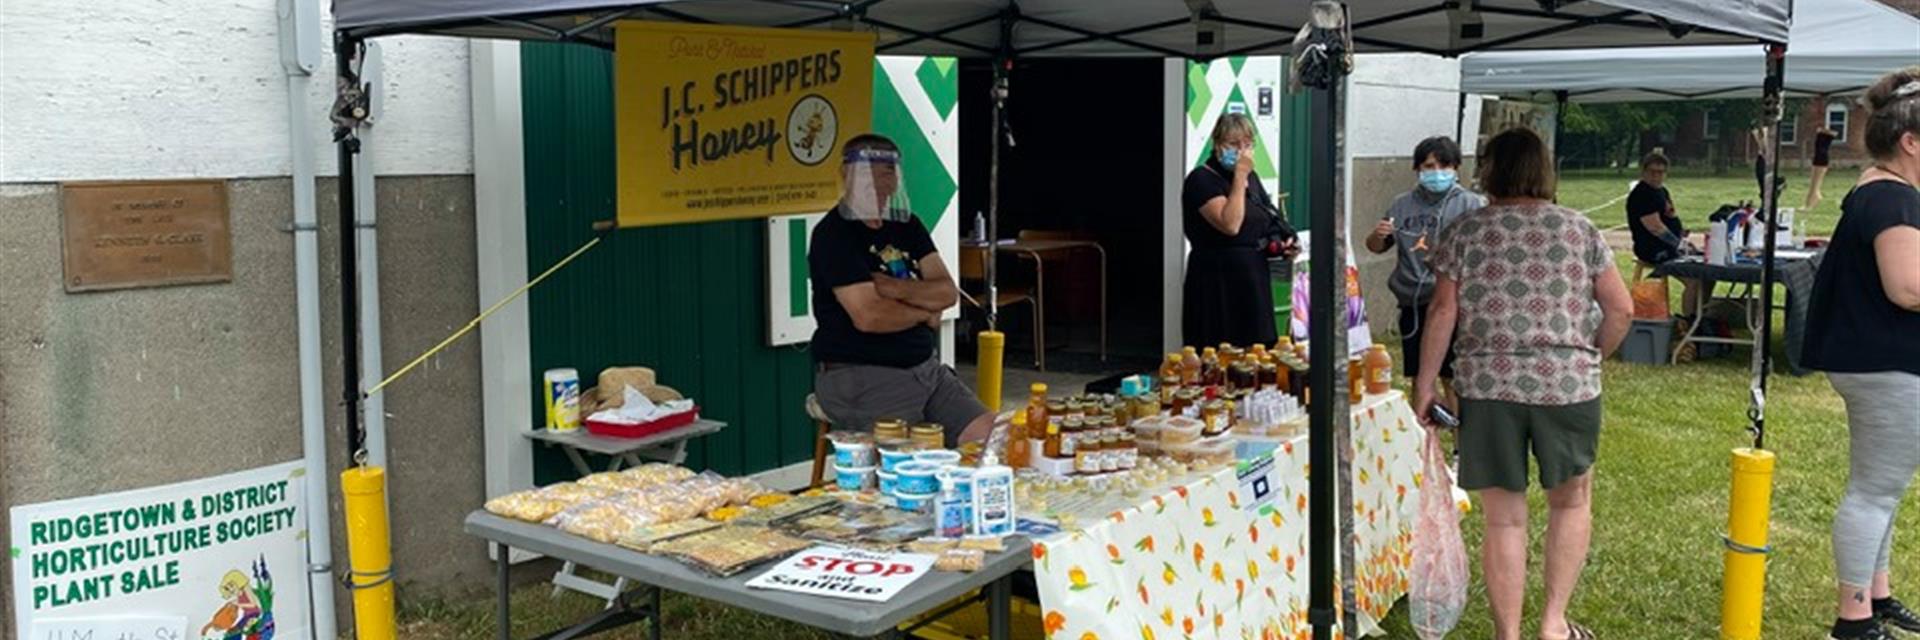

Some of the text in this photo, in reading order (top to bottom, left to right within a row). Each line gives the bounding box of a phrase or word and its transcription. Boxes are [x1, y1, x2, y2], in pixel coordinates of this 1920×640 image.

[661, 49, 842, 130] J.C. SCHIPPERS
[671, 117, 783, 171] Honey
[30, 480, 289, 545] RIDGETOWN & DISTRICT
[32, 506, 297, 578] HORTICULTURE SOCIETY
[794, 555, 914, 577] STOP
[33, 560, 180, 609] PLANT SALE
[765, 573, 883, 594] Sanitize
